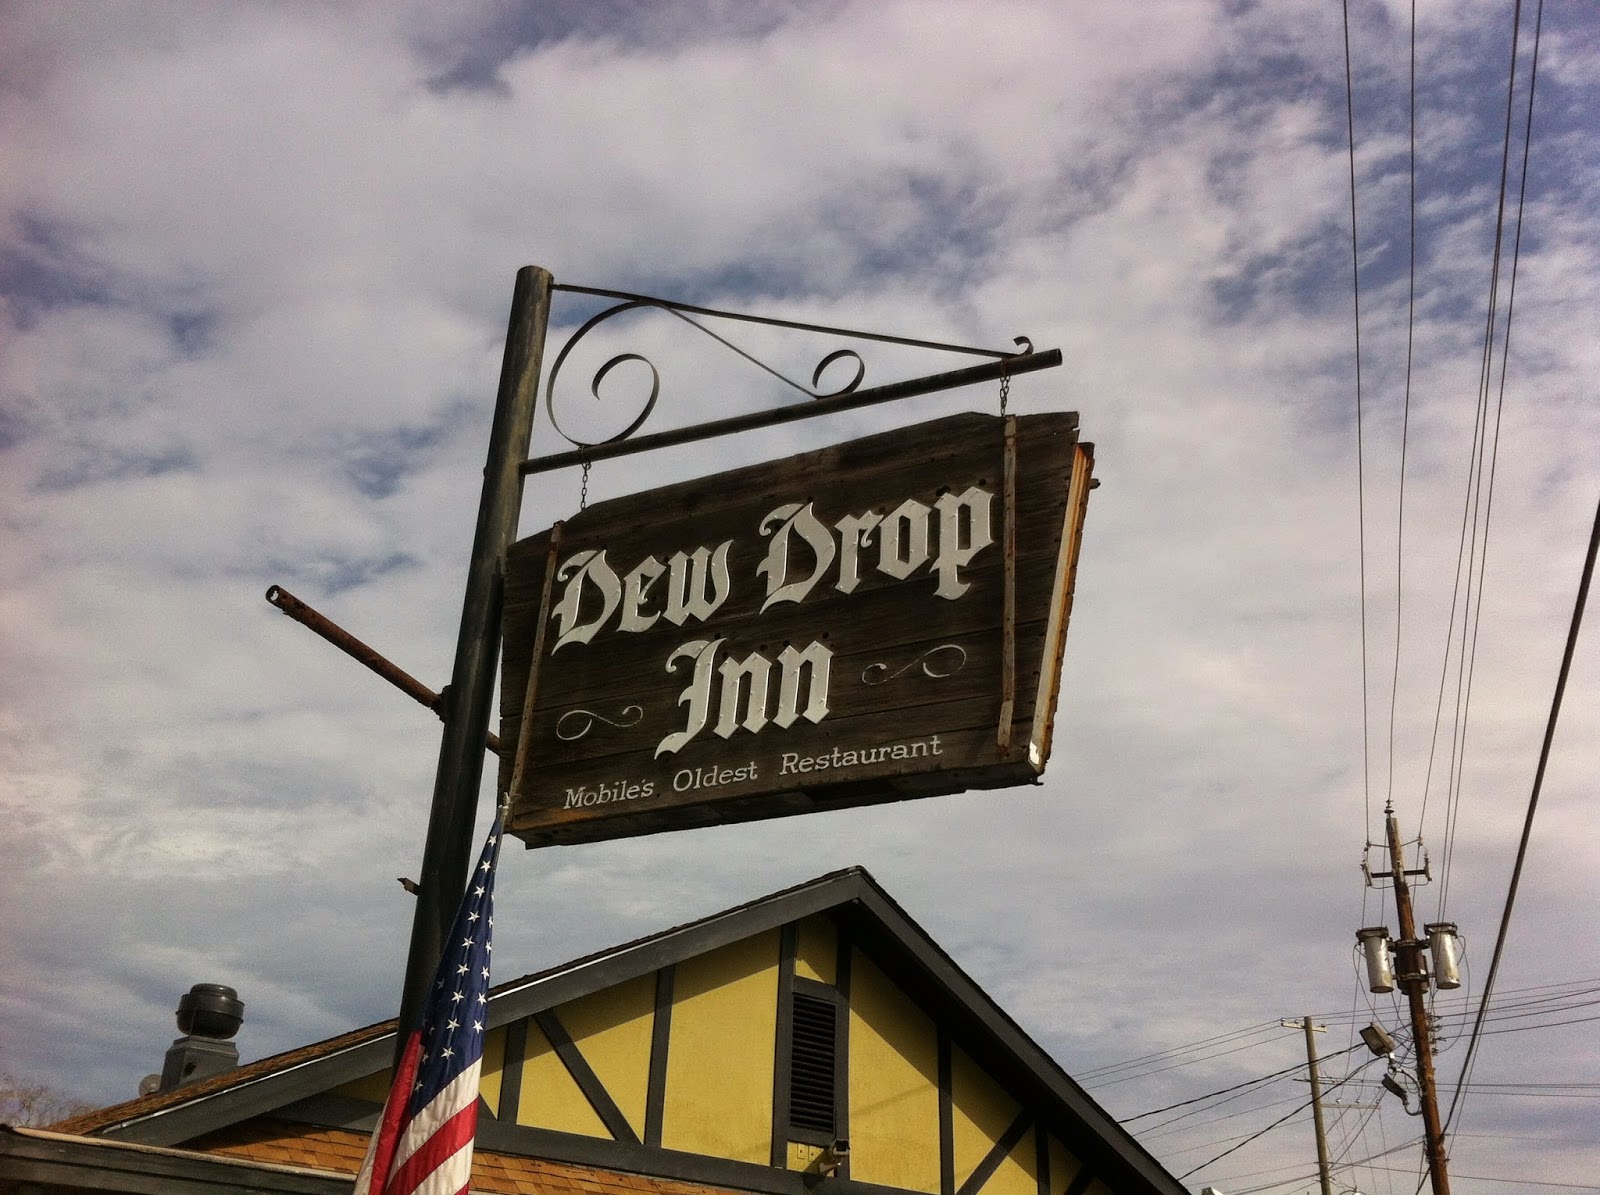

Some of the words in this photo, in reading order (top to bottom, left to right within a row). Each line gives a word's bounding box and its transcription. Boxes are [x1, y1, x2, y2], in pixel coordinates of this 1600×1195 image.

[551, 539, 734, 655] Dew
[757, 485, 995, 615] Drop
[654, 638, 834, 759] Inn
[563, 778, 654, 810] Mobile's
[673, 762, 759, 793] Oldest
[779, 735, 943, 775] Restaurant
